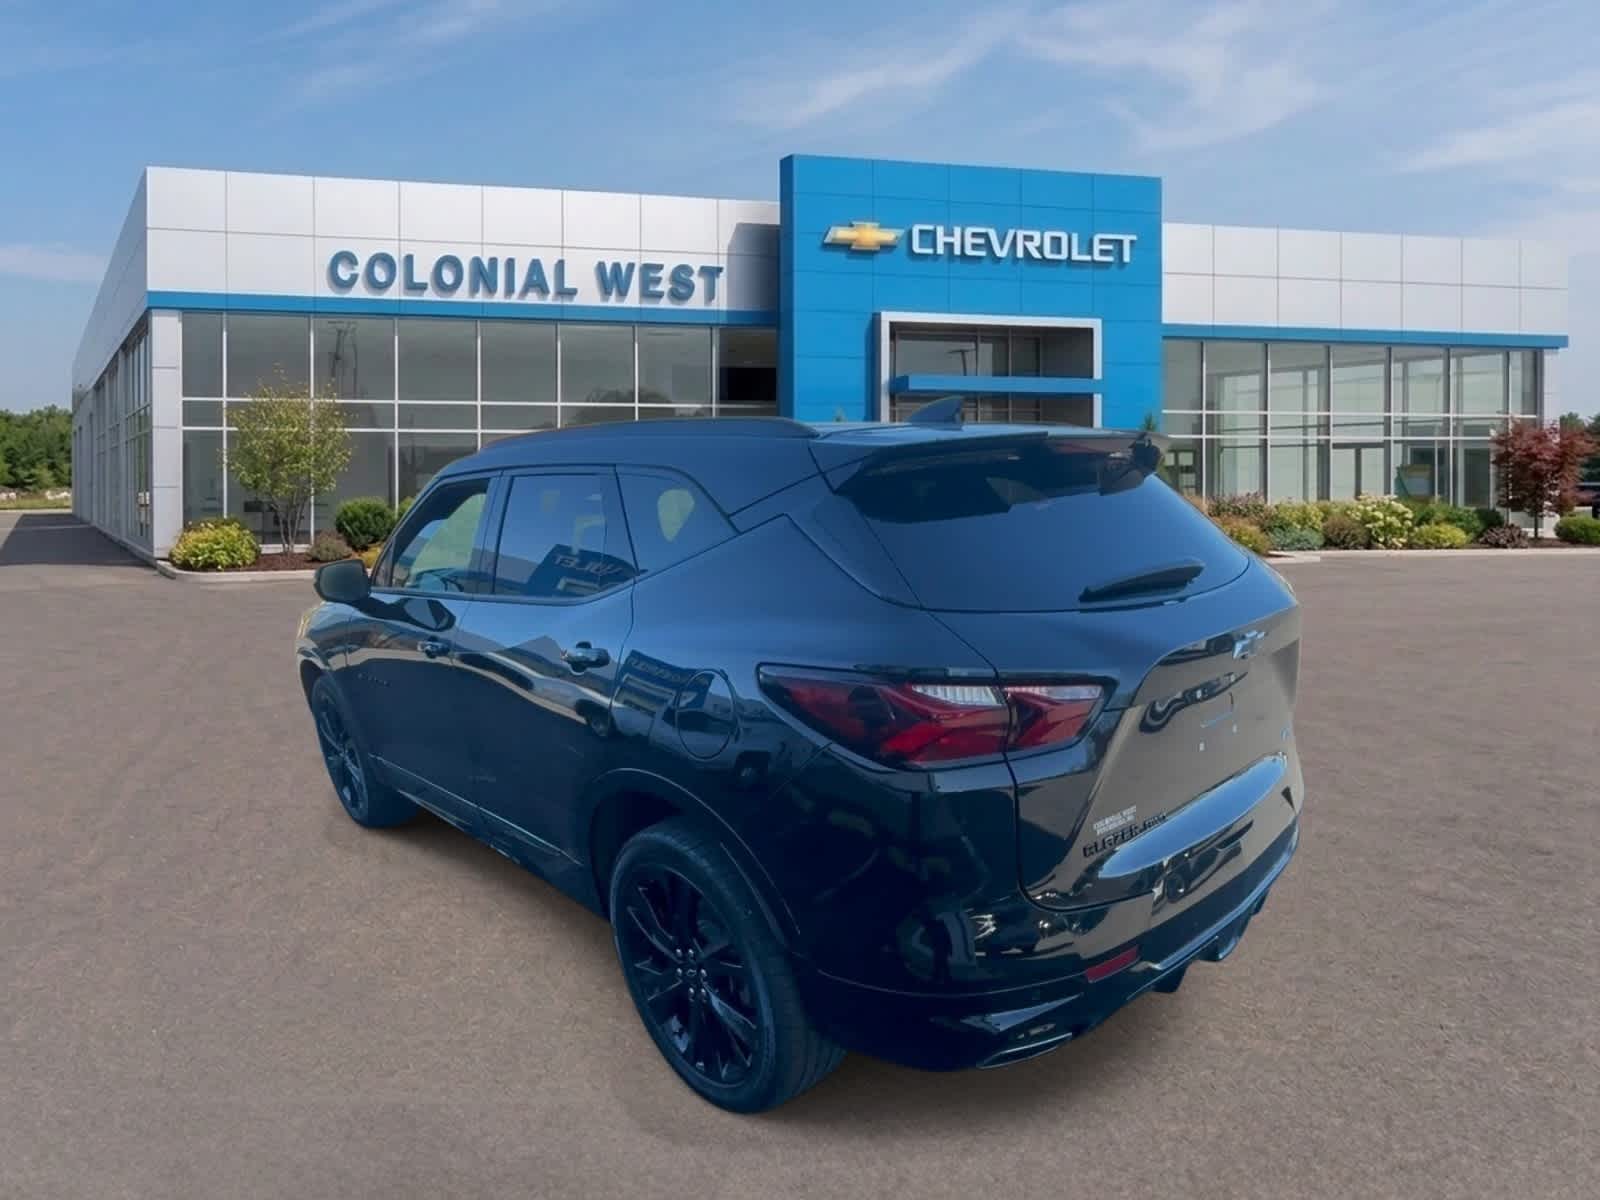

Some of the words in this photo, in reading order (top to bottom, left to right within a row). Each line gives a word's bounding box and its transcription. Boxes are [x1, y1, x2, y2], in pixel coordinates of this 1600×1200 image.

[911, 223, 1138, 264] CHEVROLET
[328, 250, 578, 299] COLONIAL
[595, 260, 724, 304] WEST
